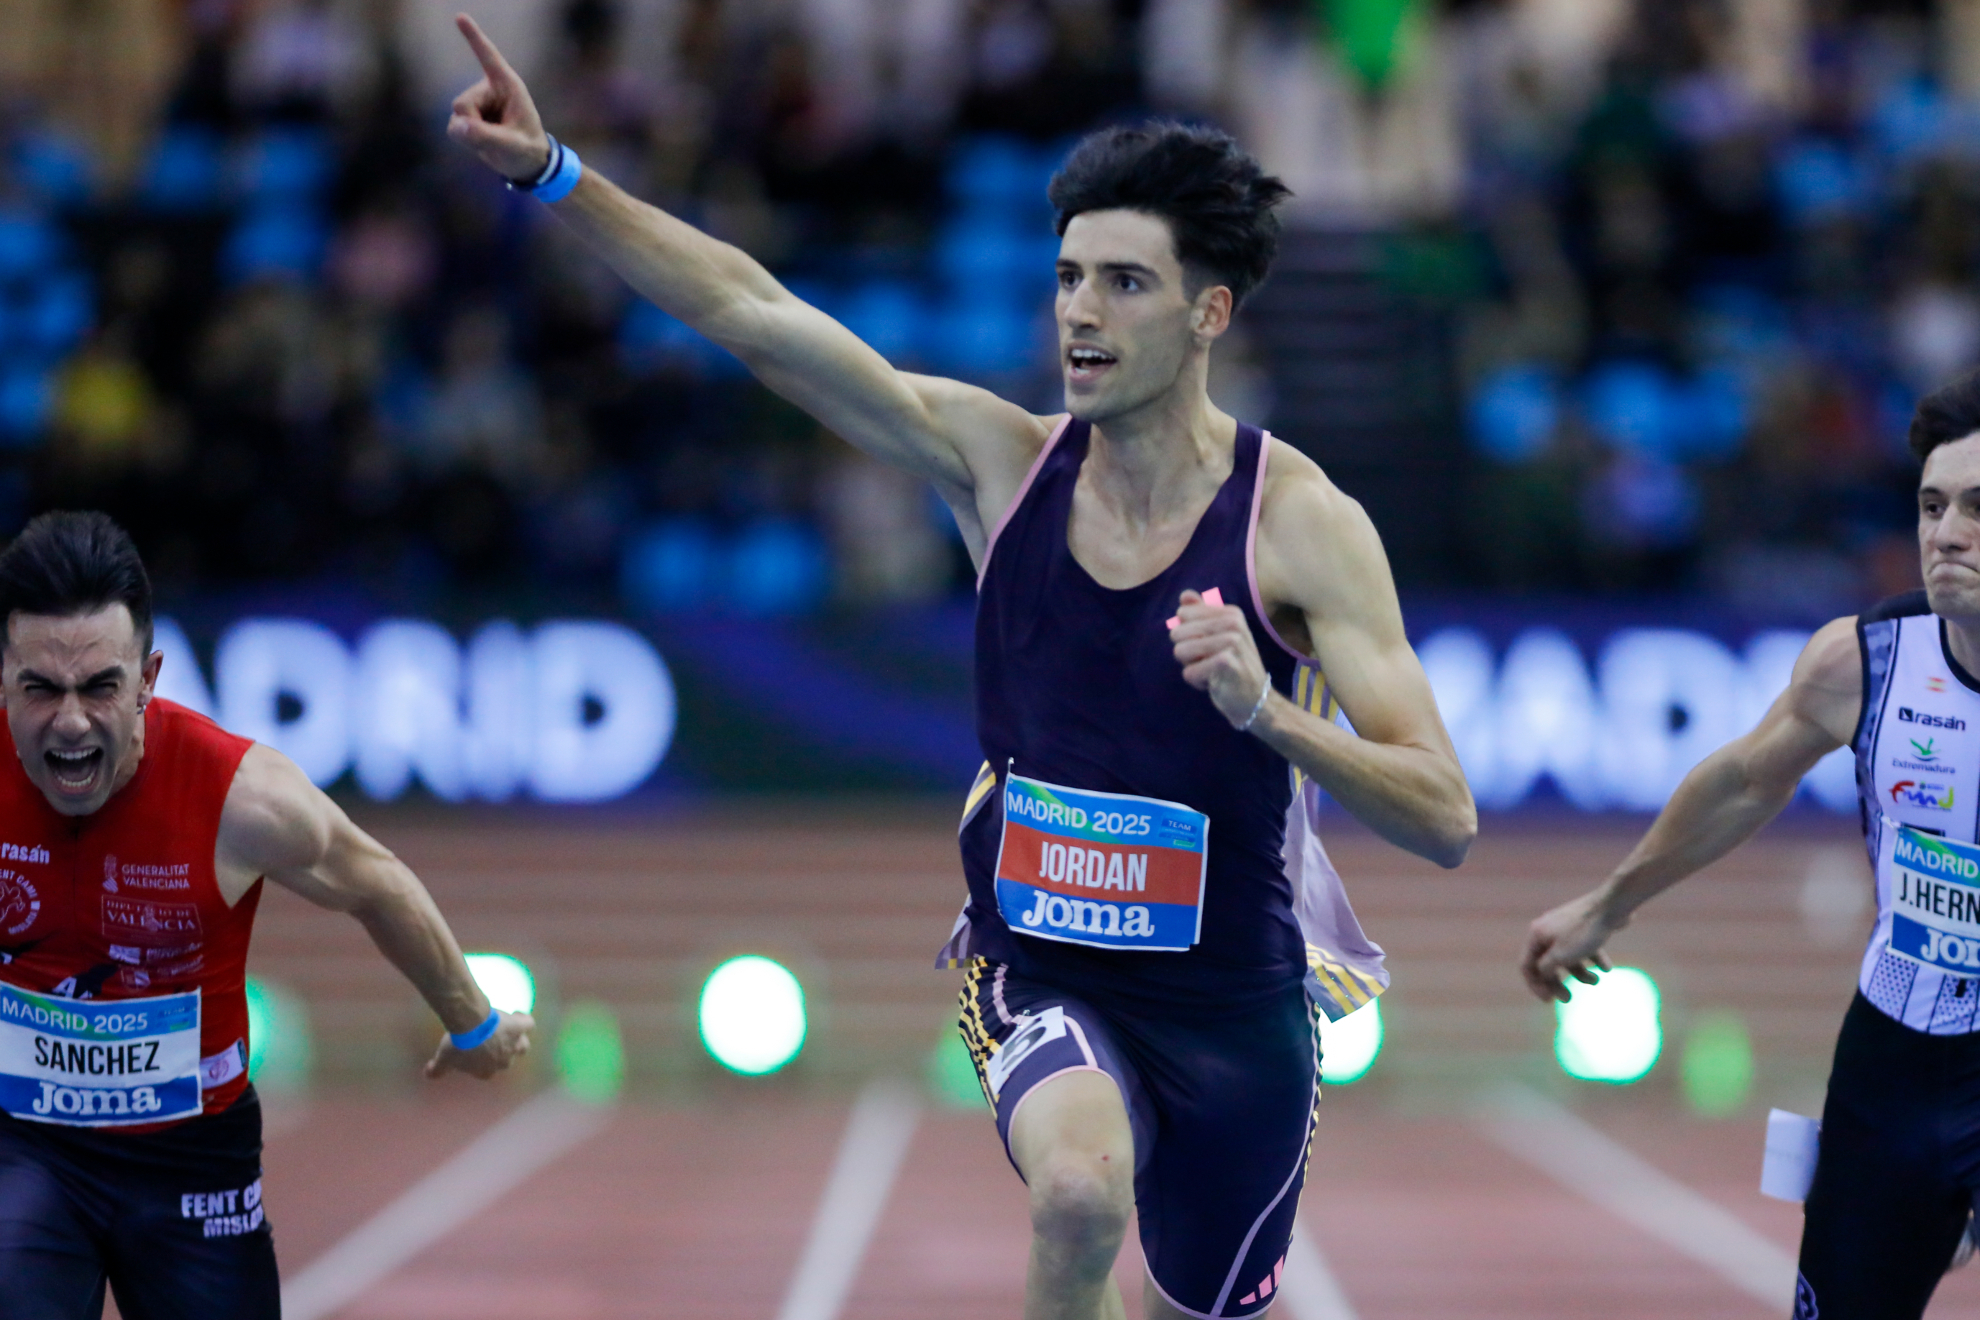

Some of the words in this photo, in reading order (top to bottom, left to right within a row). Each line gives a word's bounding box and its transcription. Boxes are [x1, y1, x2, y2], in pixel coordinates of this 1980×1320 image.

[1915, 712, 1966, 732] rasán
[1892, 758, 1956, 775] Extremadura
[1007, 791, 1088, 829] MADRID
[1092, 811, 1152, 836] 2025
[1168, 819, 1192, 832] TEAM
[121, 863, 190, 877] GENERALITAT
[1039, 841, 1148, 892] JORDAN
[1896, 837, 1979, 879] MADRID
[123, 876, 190, 890] VALENCIANA
[1021, 889, 1155, 938] Joma
[1, 996, 88, 1032] MADRID
[93, 1012, 148, 1034] 2025
[34, 1035, 161, 1076] SANCHEZ
[32, 1081, 162, 1116] Joma
[181, 1189, 239, 1219] FENT
